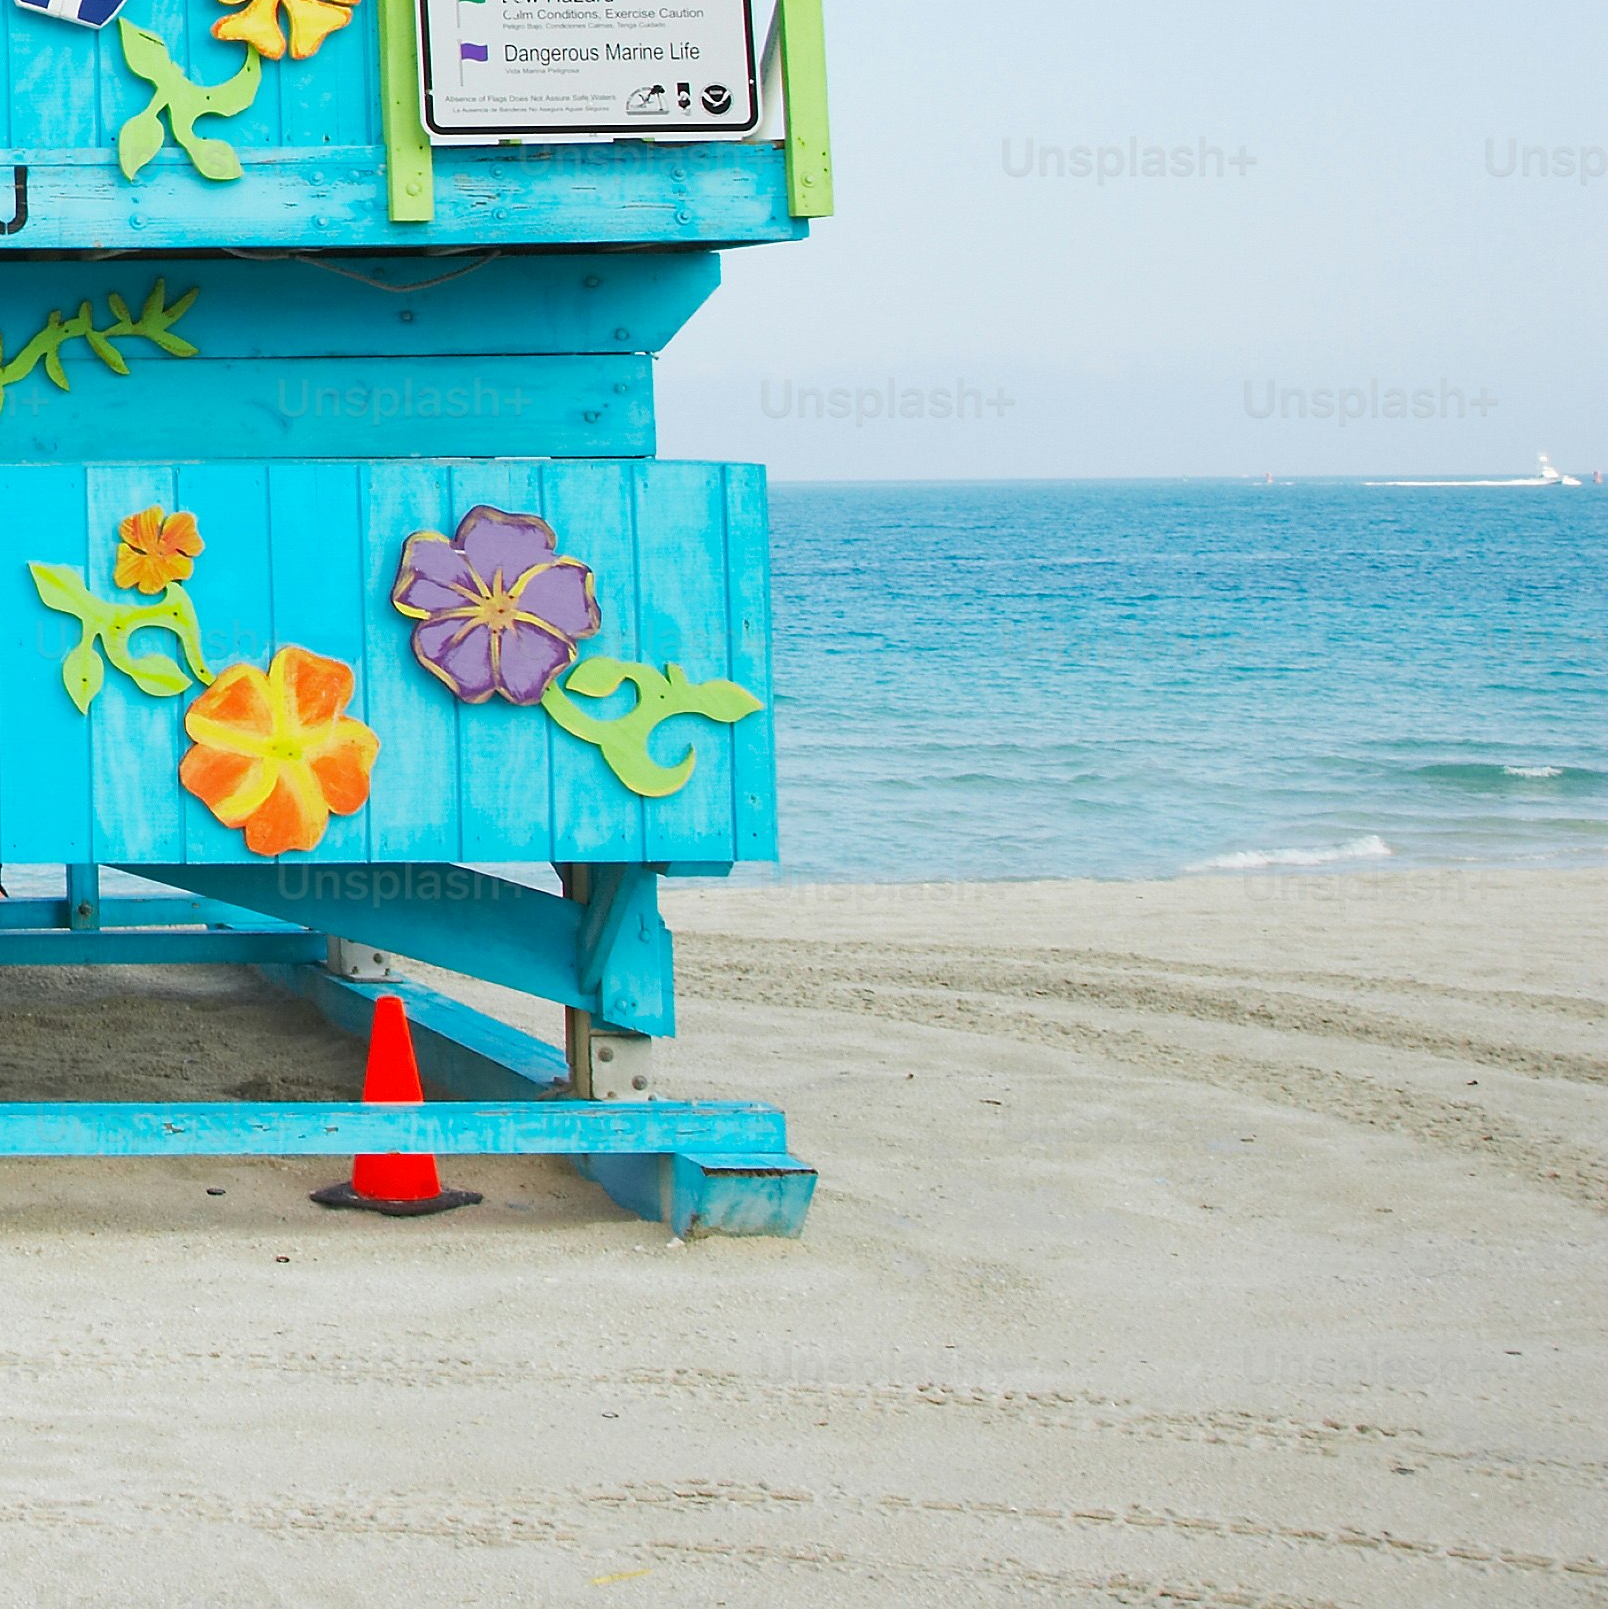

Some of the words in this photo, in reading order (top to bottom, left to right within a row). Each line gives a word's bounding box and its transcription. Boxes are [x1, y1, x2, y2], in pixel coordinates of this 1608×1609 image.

[537, 9, 604, 20] Conditions,
[605, 8, 657, 19] Exercise
[658, 7, 704, 19] Caution
[504, 44, 600, 65] Dangerous
[605, 43, 664, 61] Marine
[669, 42, 700, 60] Life
